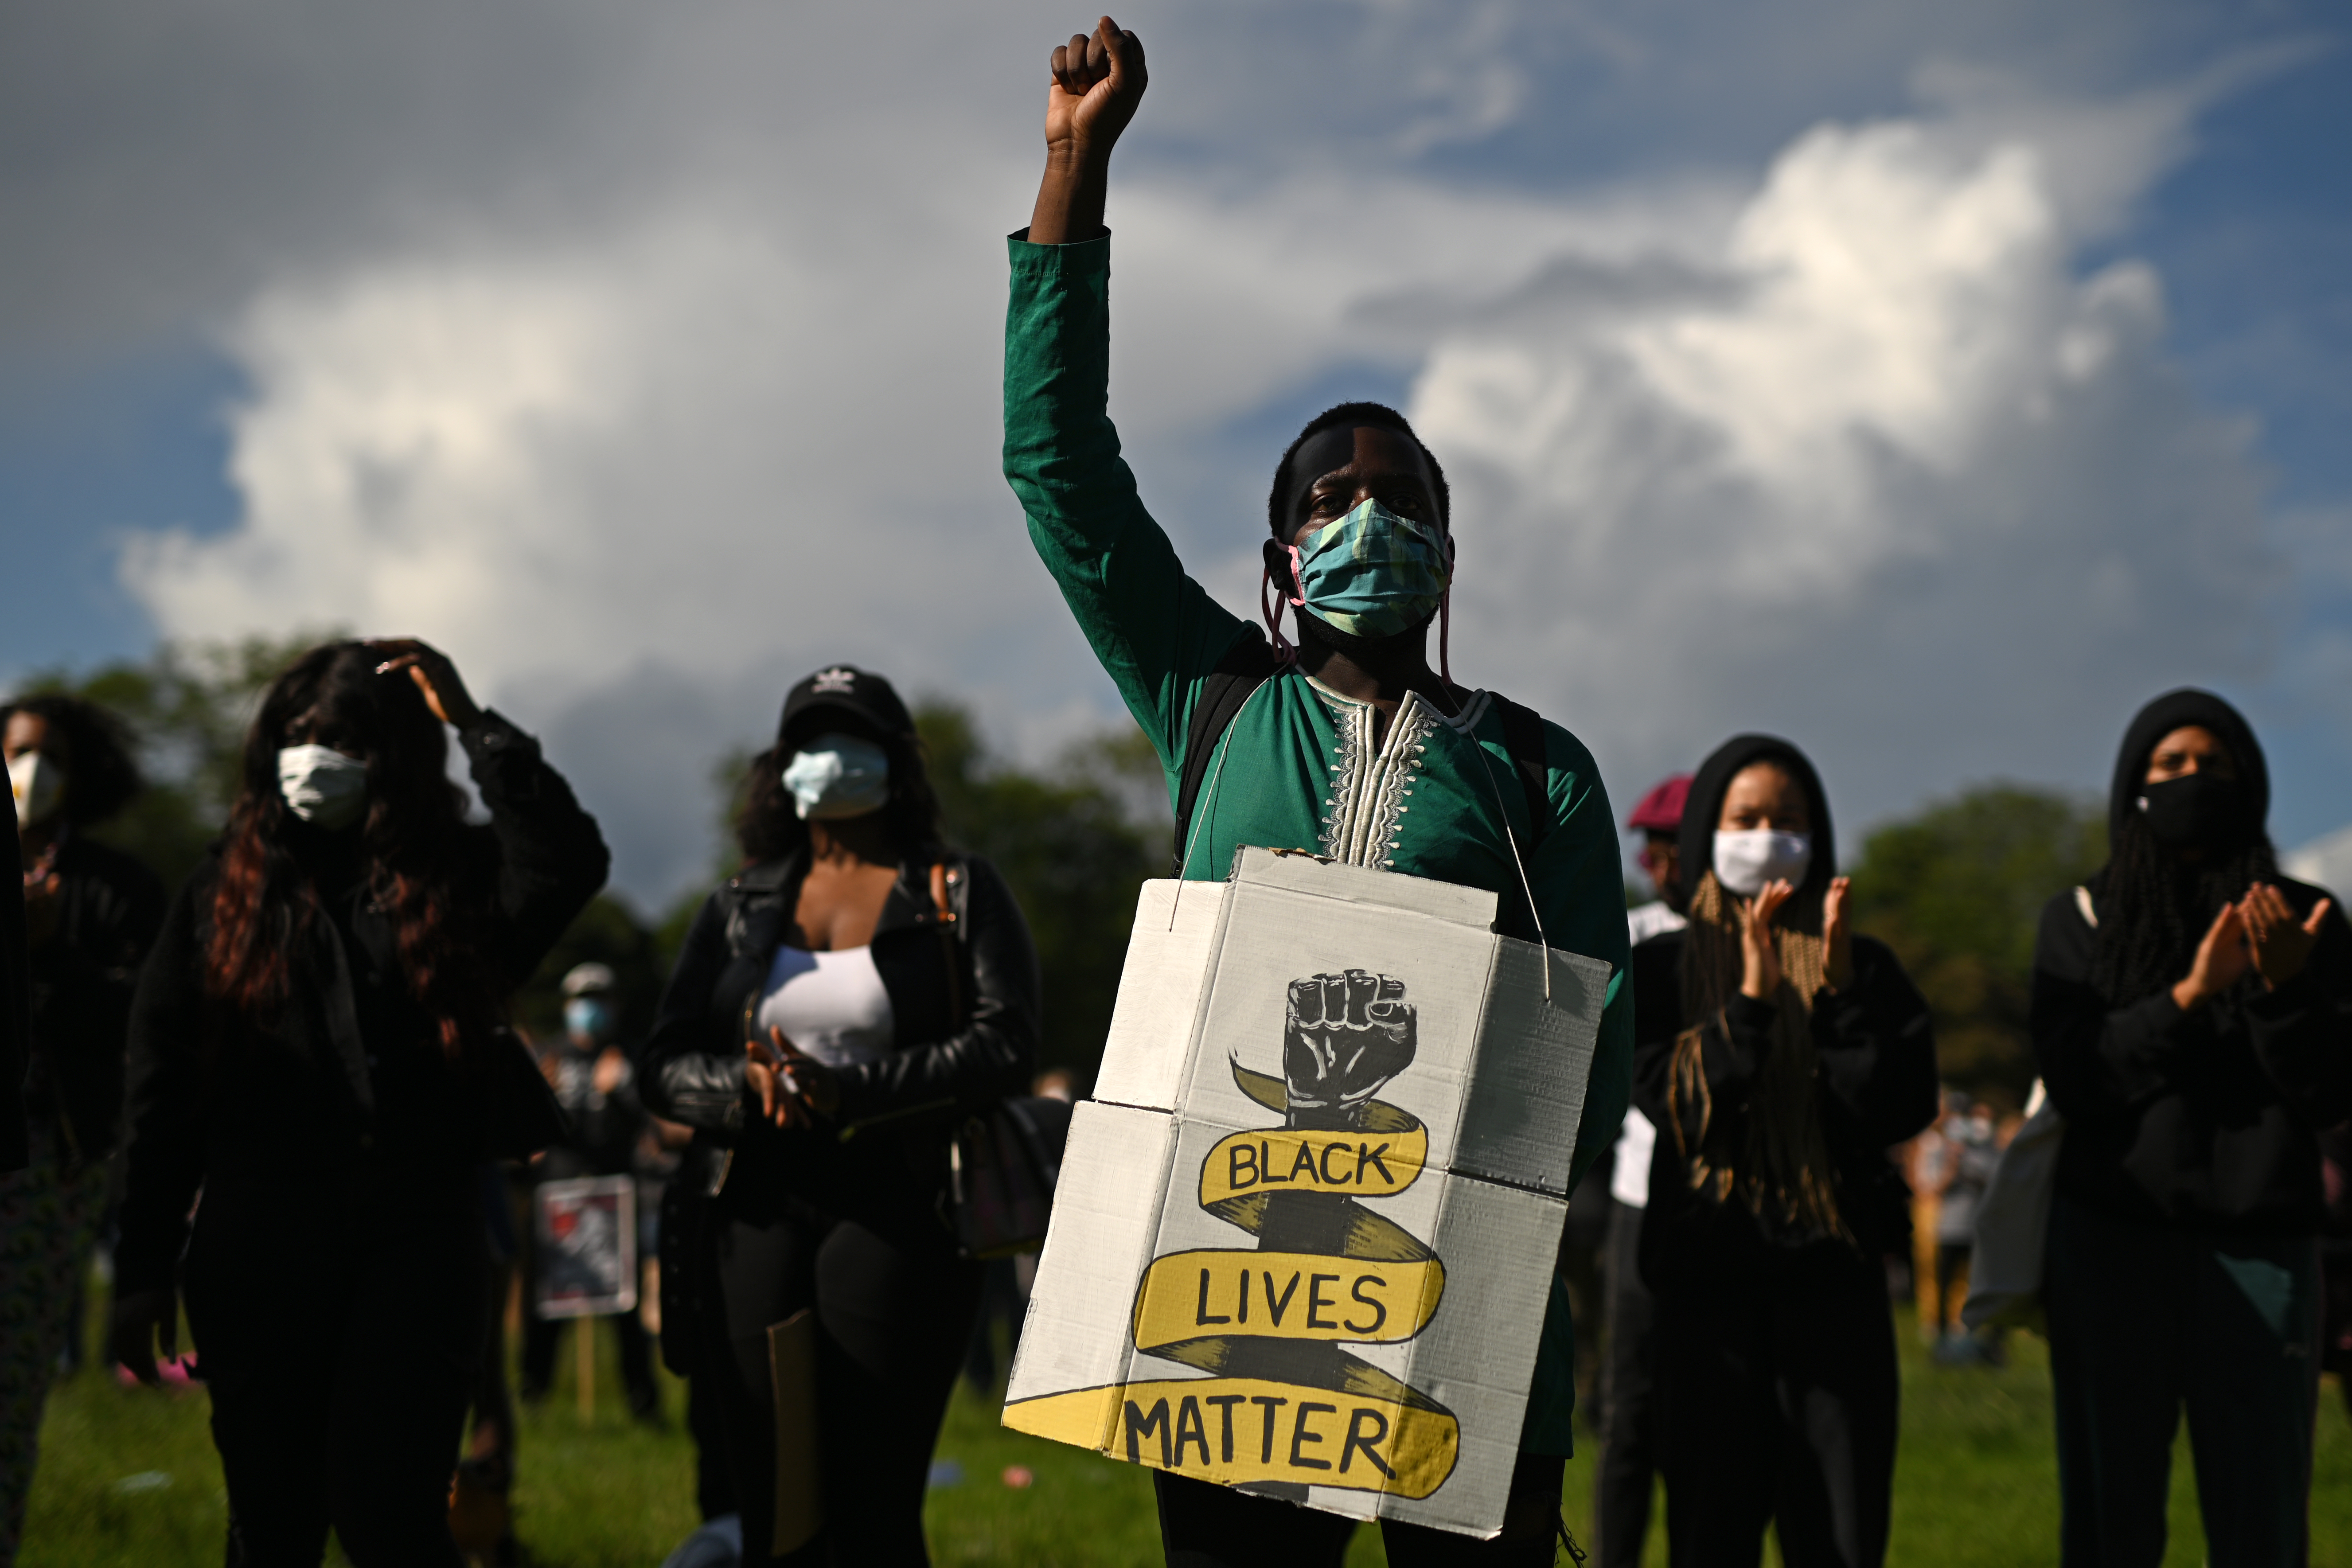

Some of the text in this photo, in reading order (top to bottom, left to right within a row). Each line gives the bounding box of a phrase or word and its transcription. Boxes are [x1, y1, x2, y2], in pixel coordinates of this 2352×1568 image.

[1229, 1141, 1395, 1190] BLACK
[1196, 1269, 1387, 1333] LIVES
[1124, 1396, 1396, 1479] MATTER
